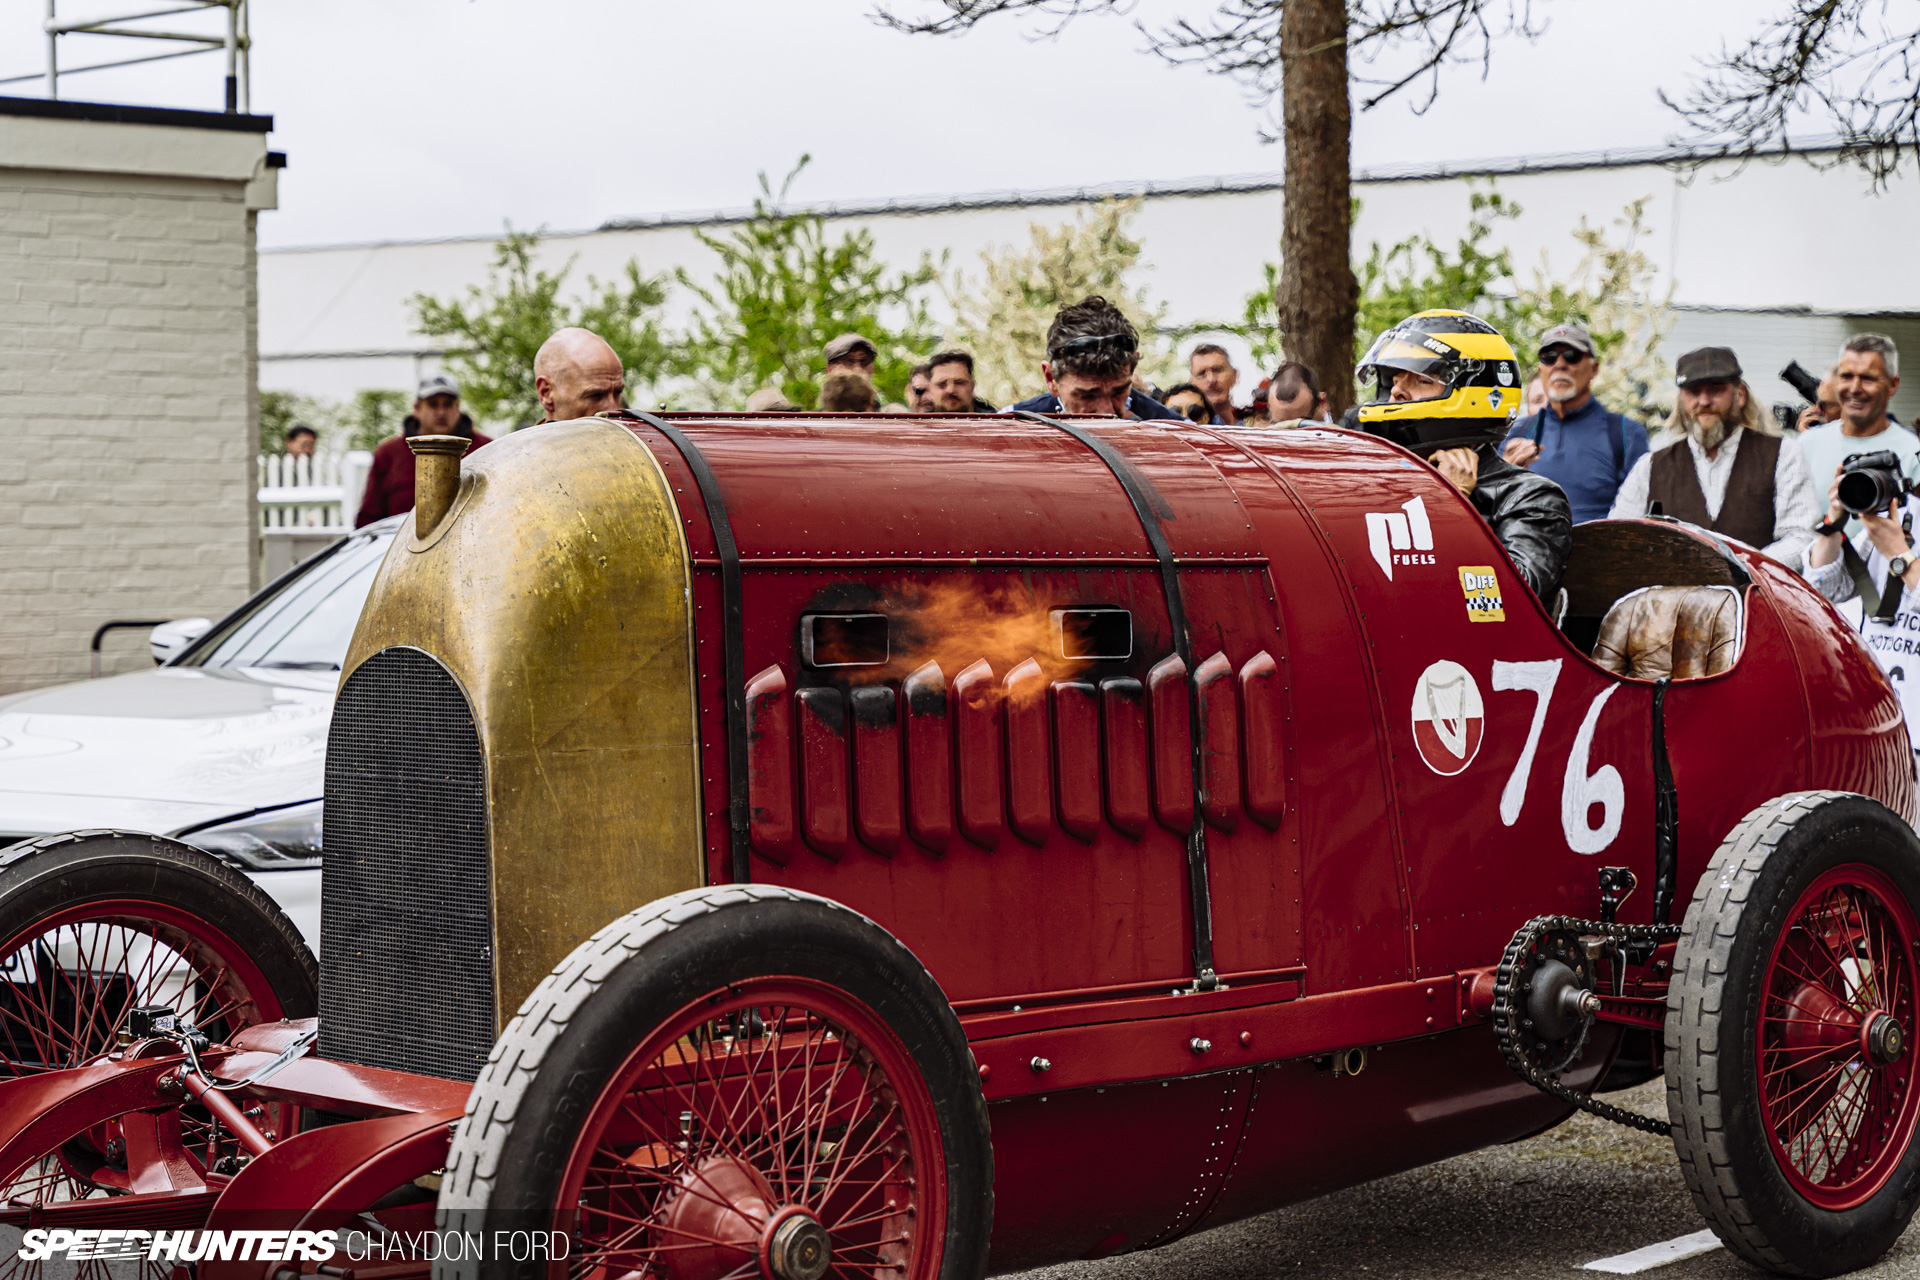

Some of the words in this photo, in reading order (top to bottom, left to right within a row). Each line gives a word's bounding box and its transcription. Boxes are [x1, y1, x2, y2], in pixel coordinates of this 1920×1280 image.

[1393, 554, 1436, 566] FUELS
[1464, 572, 1495, 592] DIFF
[1491, 658, 1625, 855] 76
[152, 843, 234, 887] GOODRICH
[237, 880, 312, 968] SILVERTOWN
[534, 1069, 592, 1173] CORD
